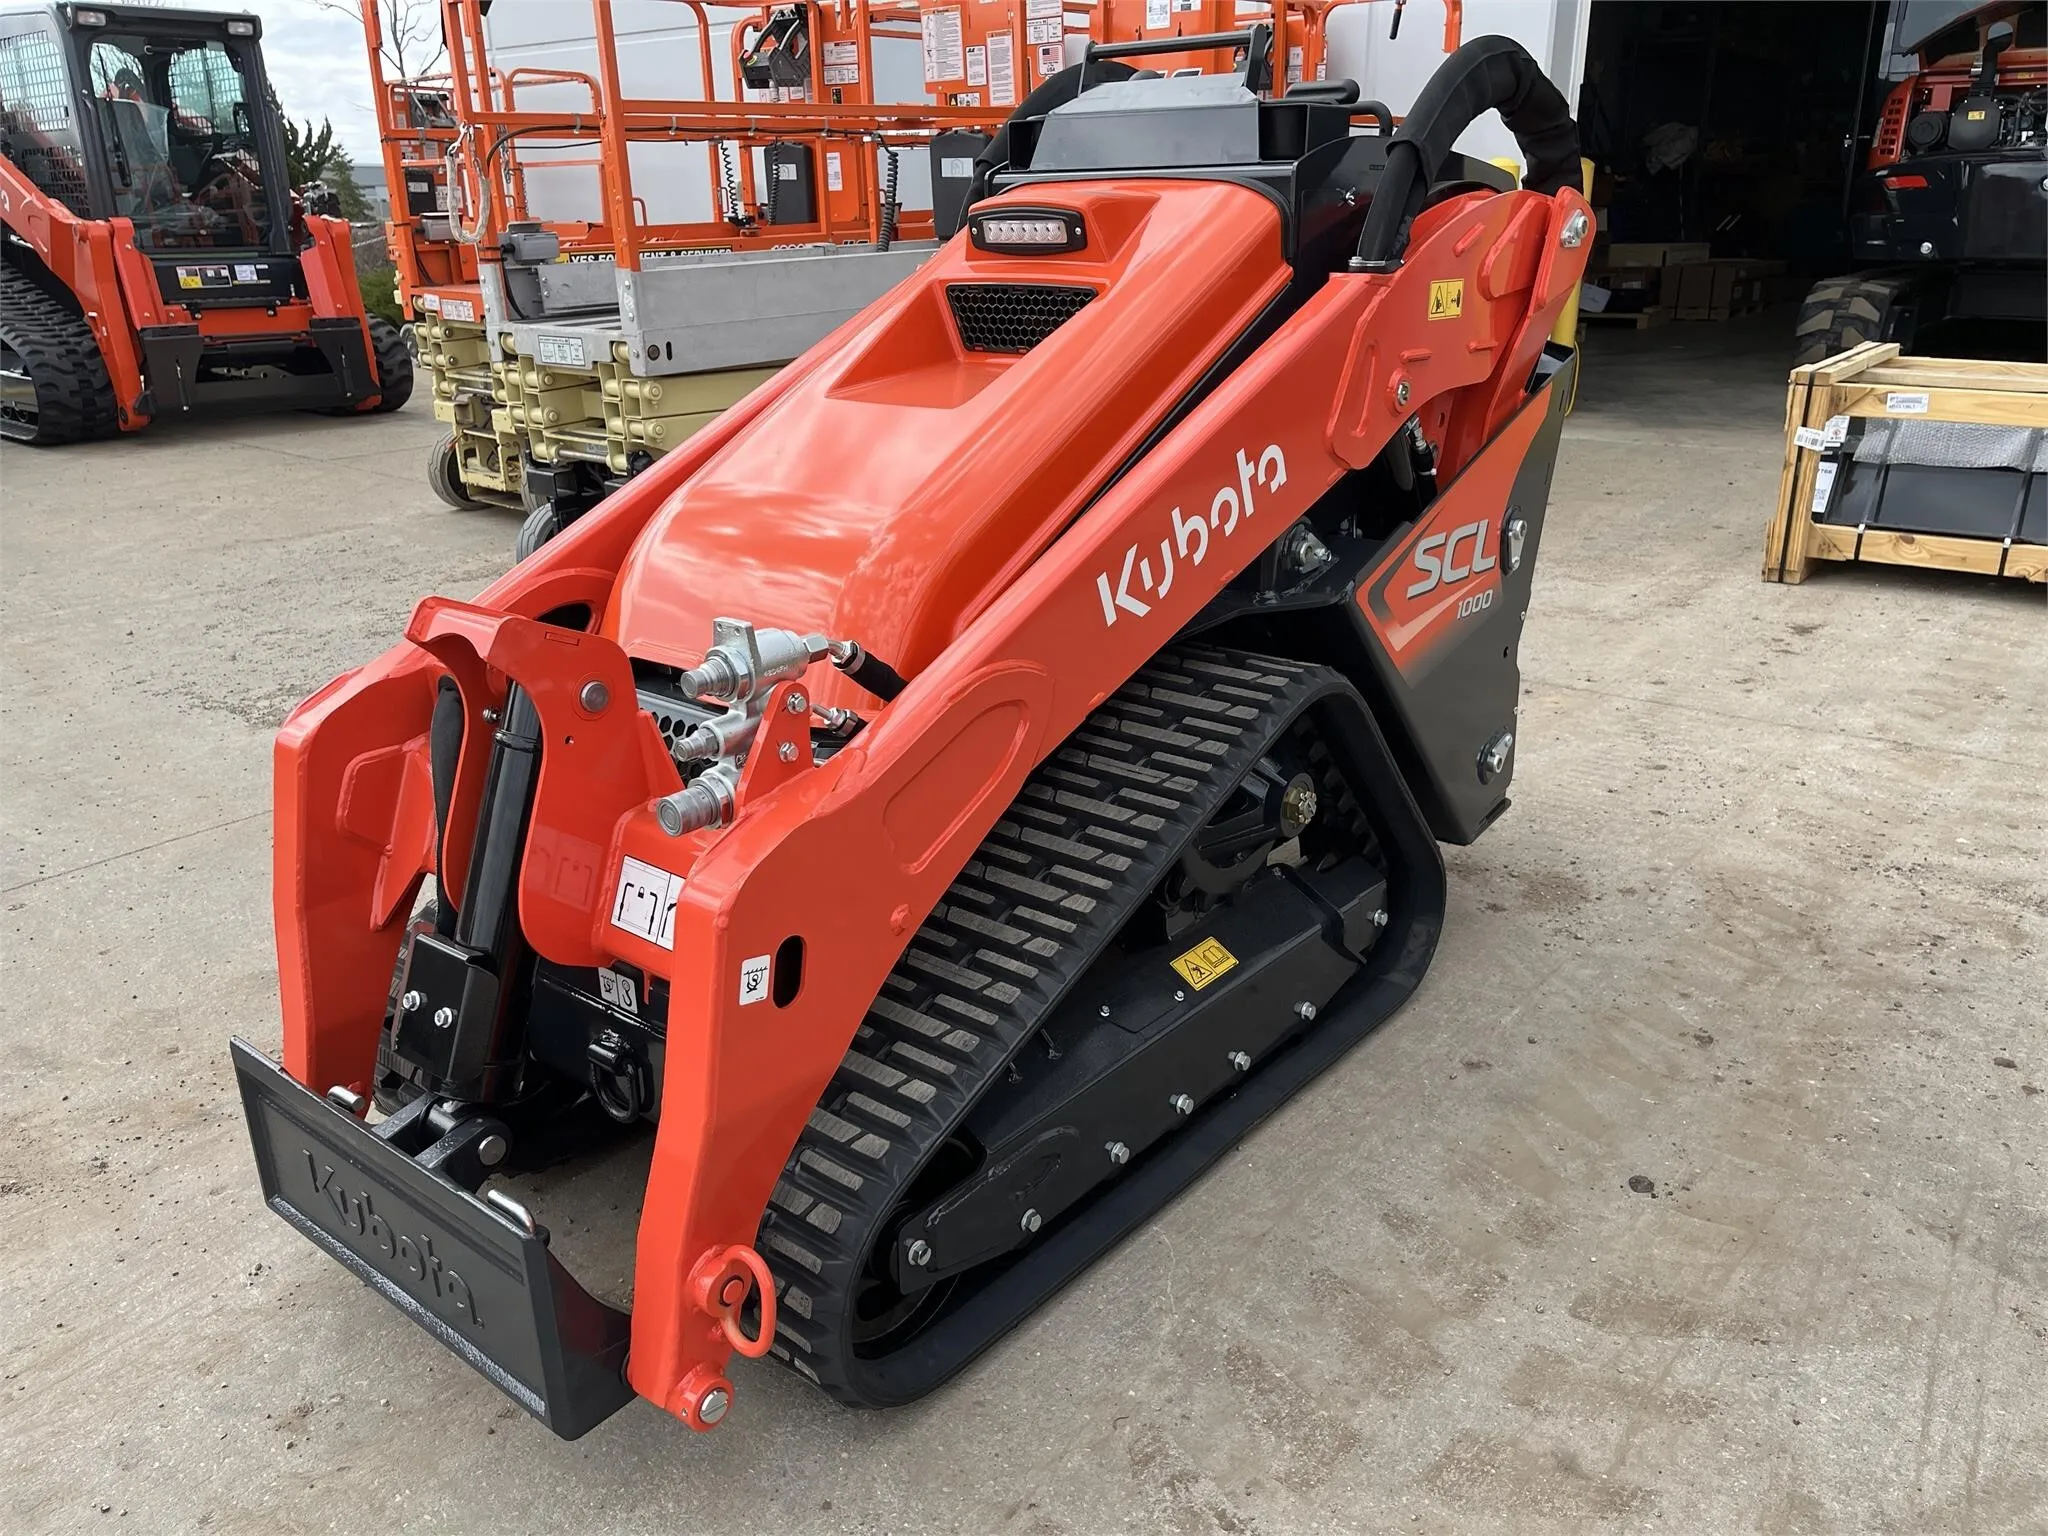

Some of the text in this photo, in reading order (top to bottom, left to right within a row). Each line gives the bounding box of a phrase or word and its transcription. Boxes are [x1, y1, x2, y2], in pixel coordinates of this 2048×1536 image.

[1097, 444, 1287, 627] Kubota
[1407, 519, 1496, 600] SCL
[1456, 589, 1493, 619] 1000
[303, 1149, 485, 1328] Kubota
